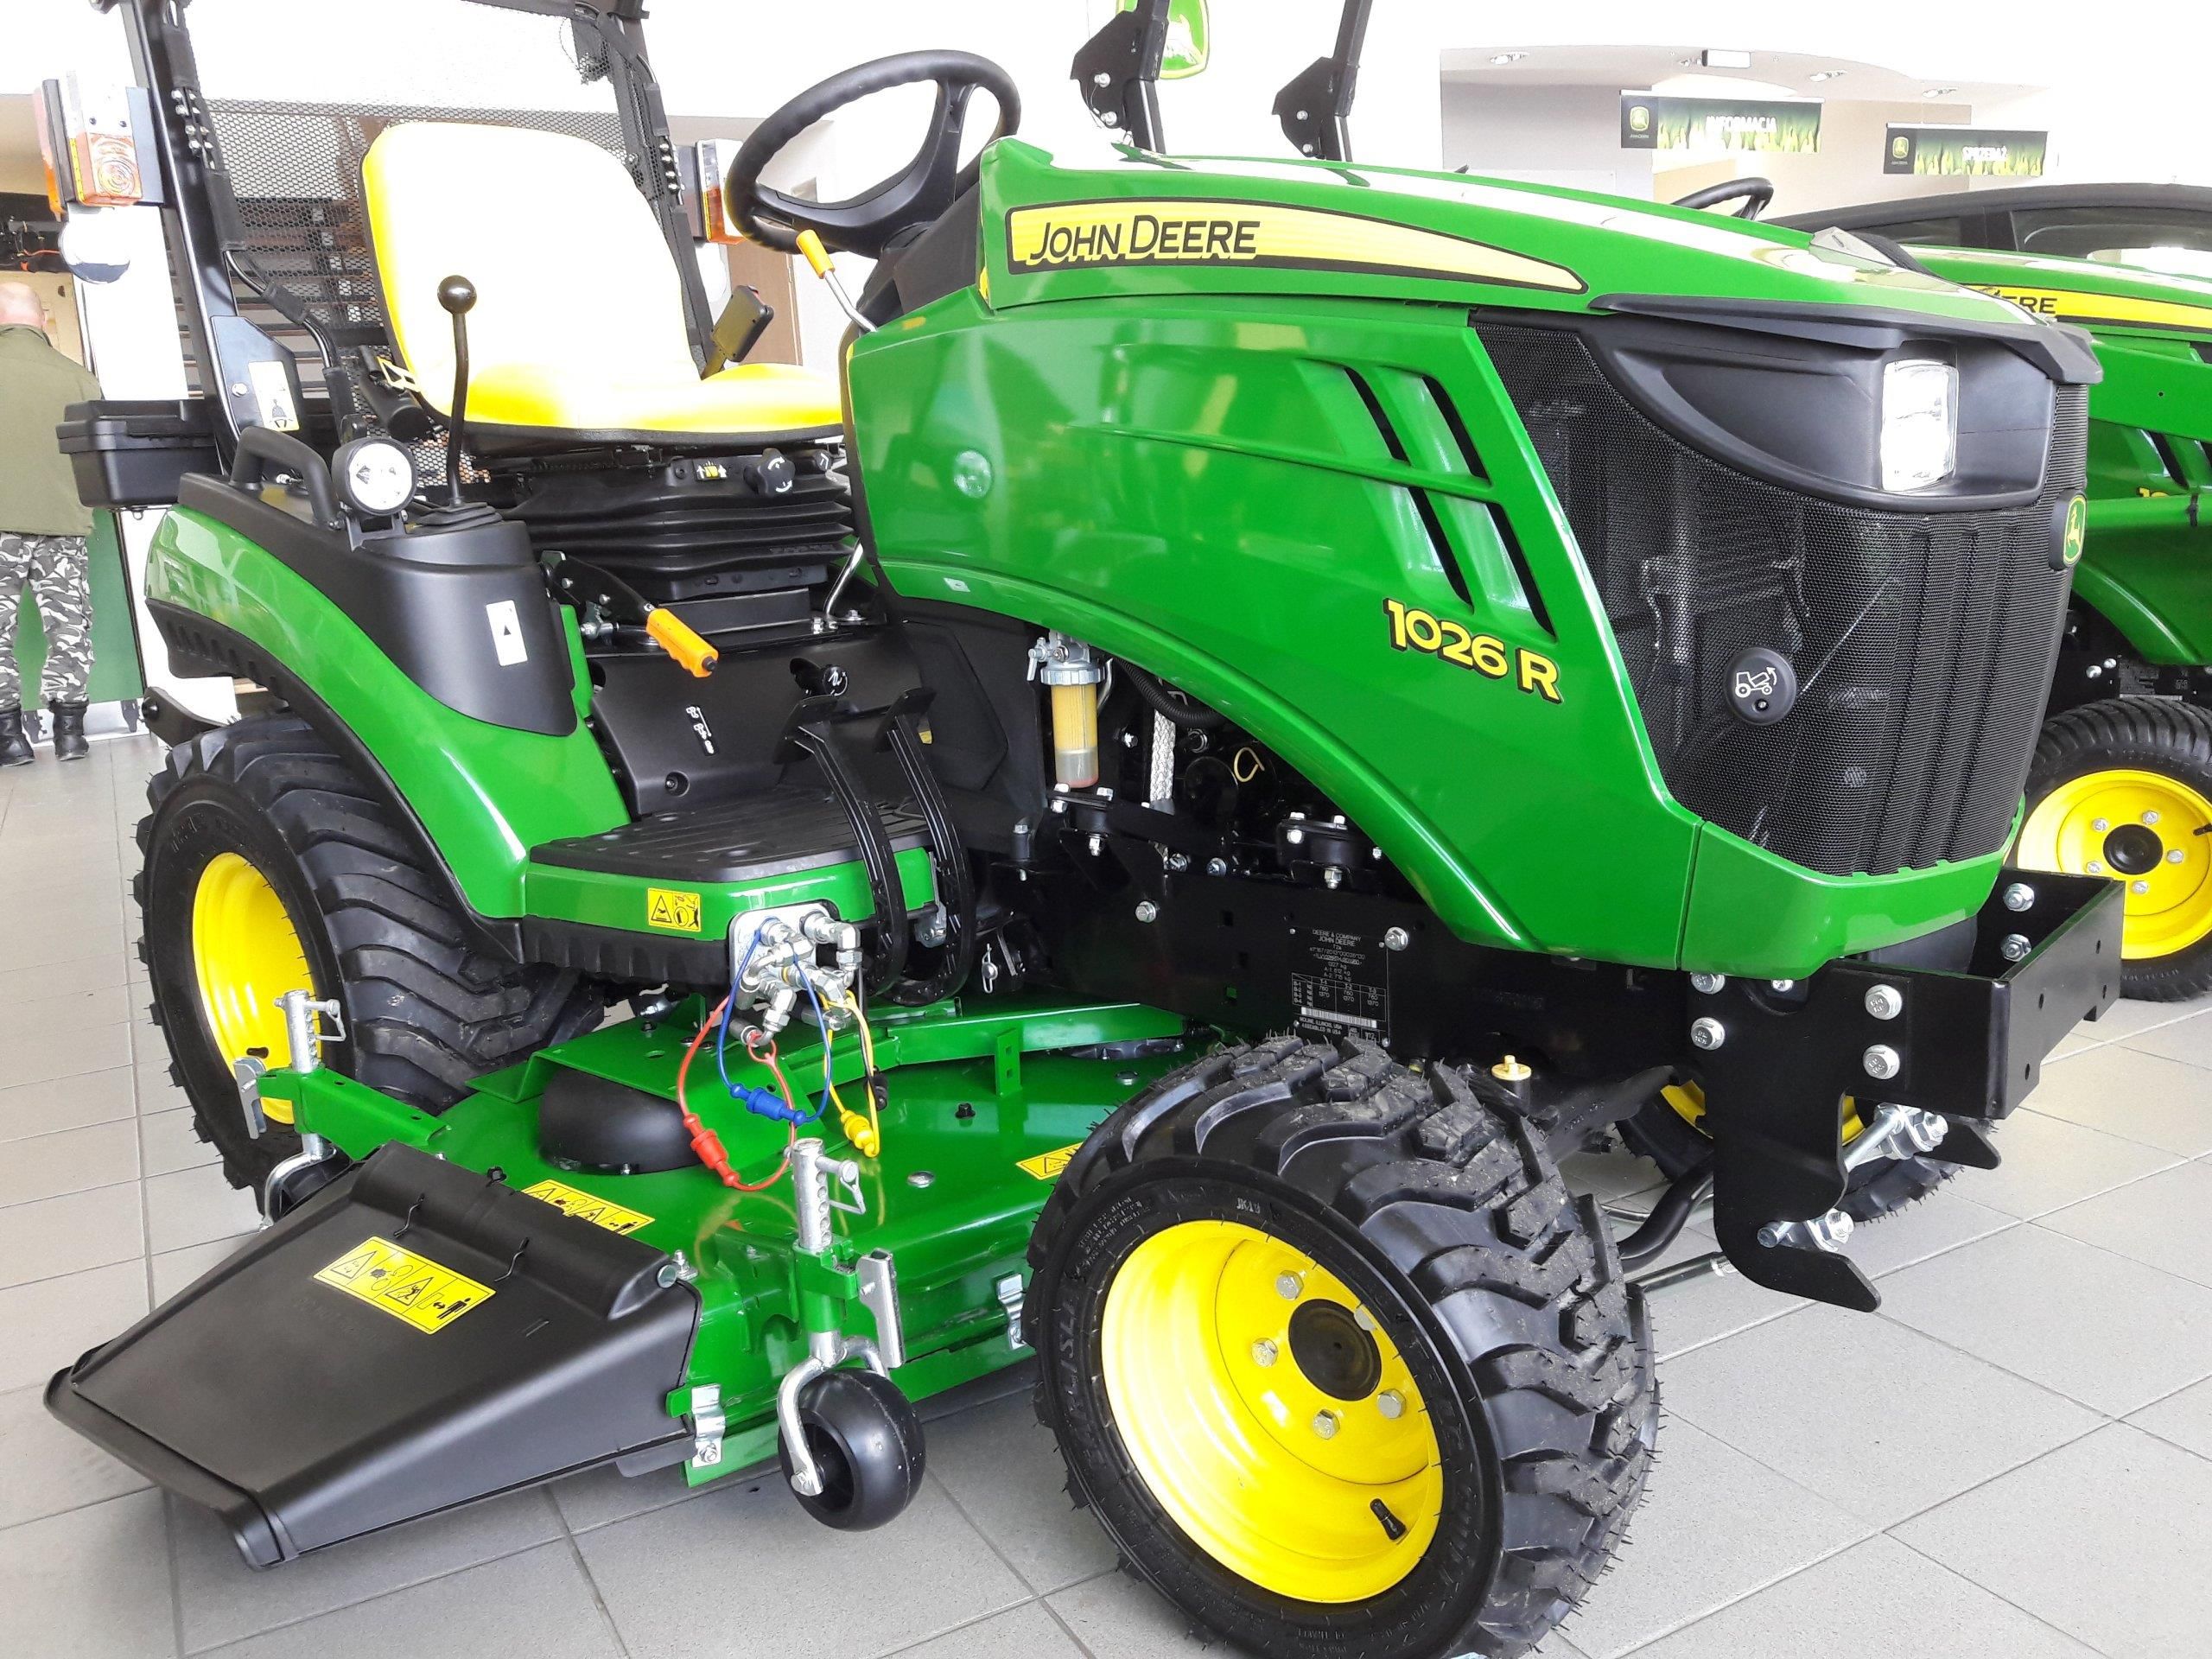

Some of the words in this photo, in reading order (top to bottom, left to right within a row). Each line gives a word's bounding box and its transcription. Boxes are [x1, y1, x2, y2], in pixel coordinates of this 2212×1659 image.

[1029, 221, 1122, 260] JOHN
[1129, 214, 1261, 254] DEERE
[1384, 598, 1509, 680] 1026
[1516, 648, 1565, 705] R
[1319, 936, 1335, 944] JOHN
[1335, 938, 1357, 947] DEERE
